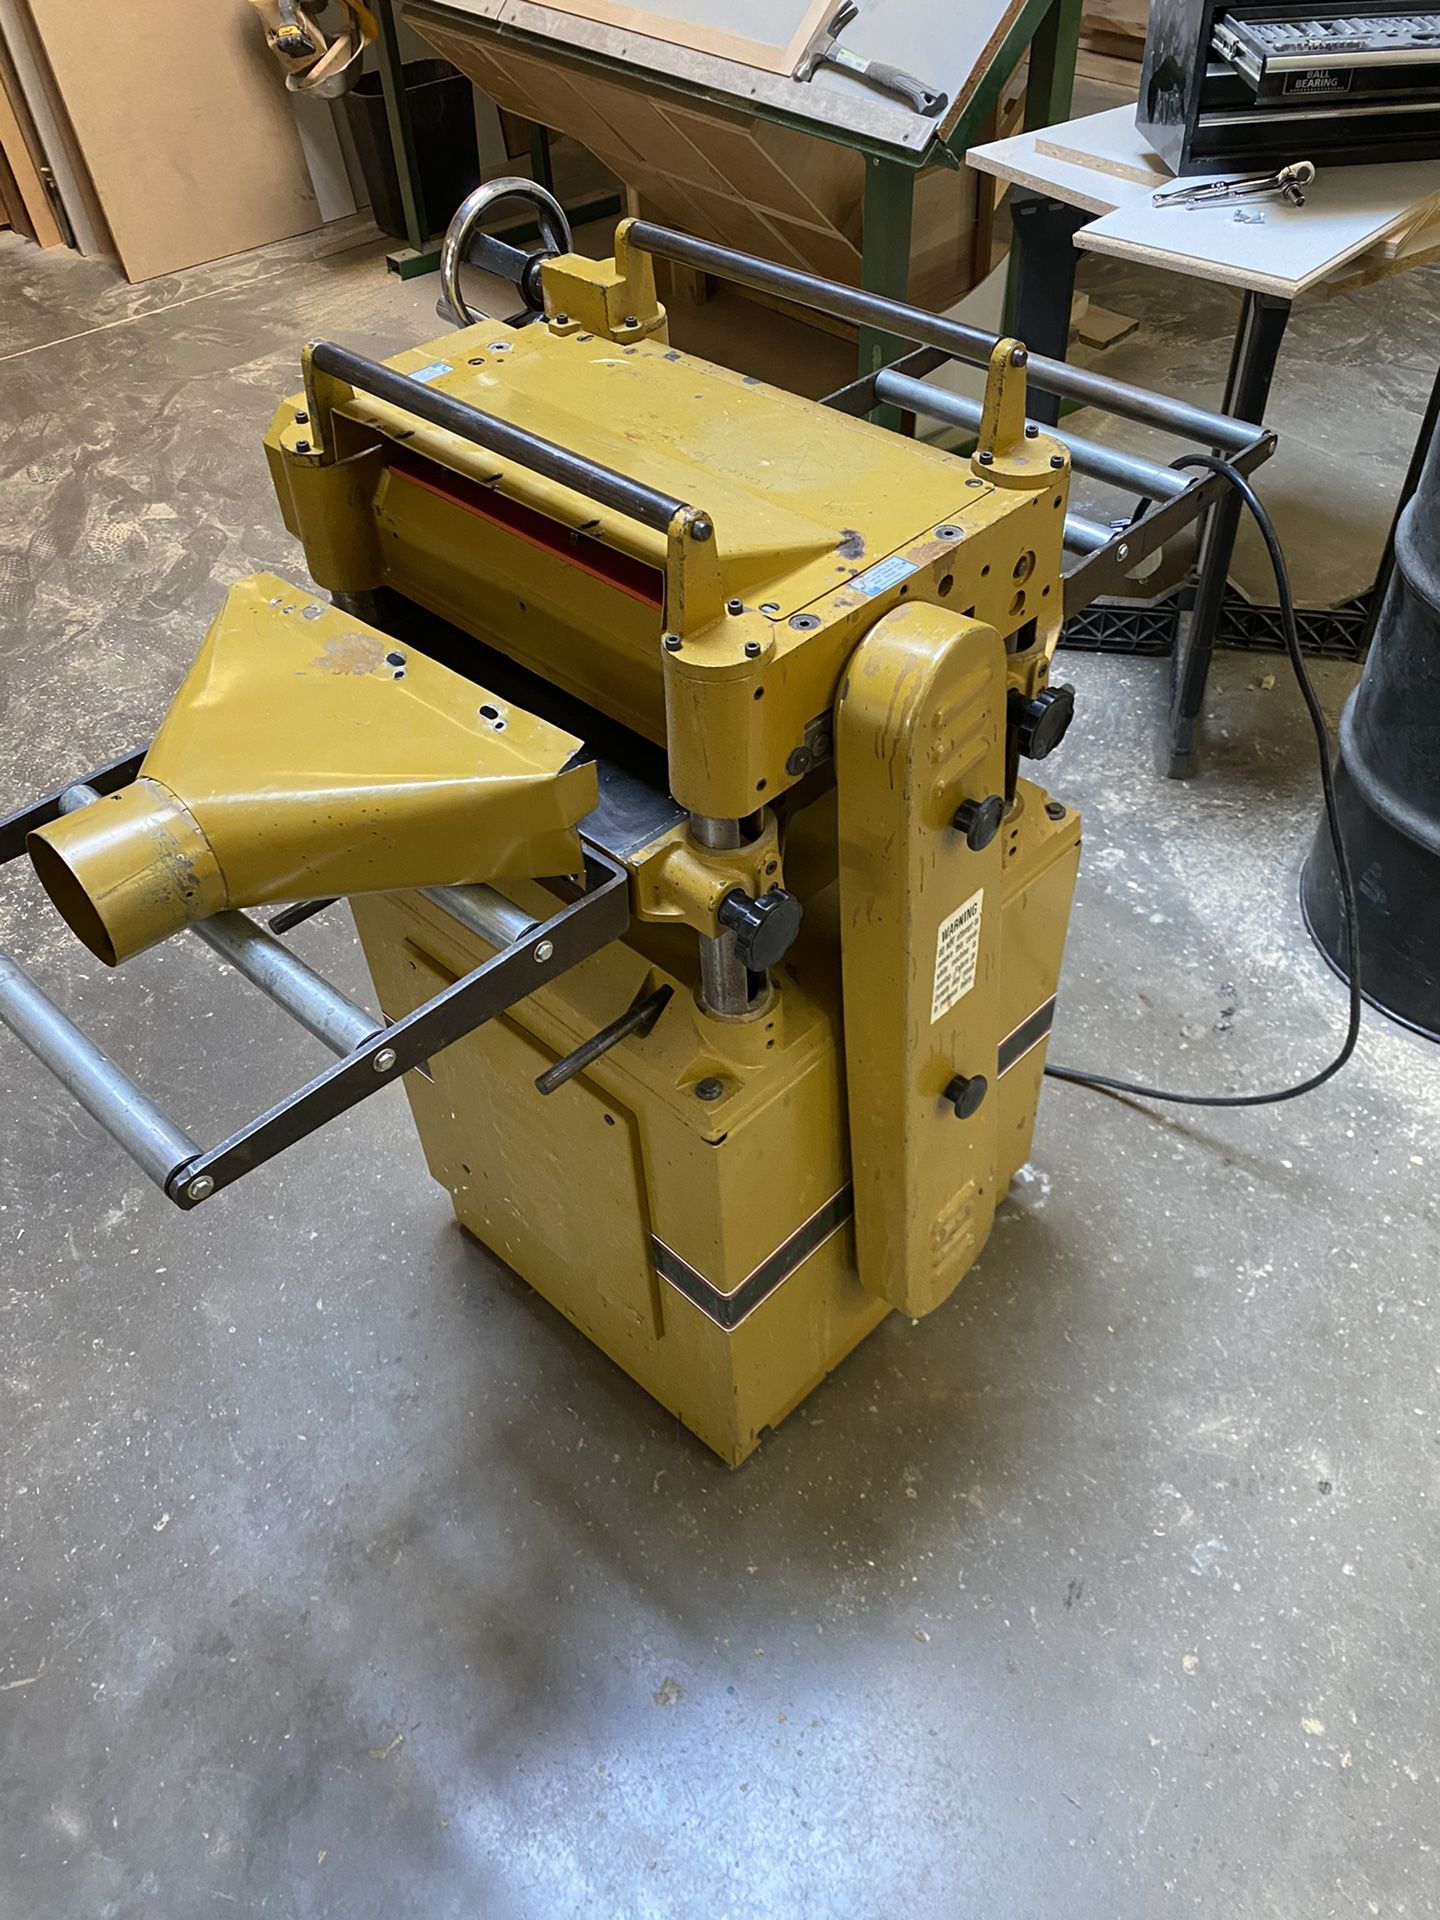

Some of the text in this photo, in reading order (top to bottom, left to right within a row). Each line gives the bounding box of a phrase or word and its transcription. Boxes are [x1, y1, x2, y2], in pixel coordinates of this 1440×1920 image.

[1306, 70, 1330, 79] BALL
[1295, 77, 1339, 88] BEARING
[941, 902, 978, 942] WARNING
